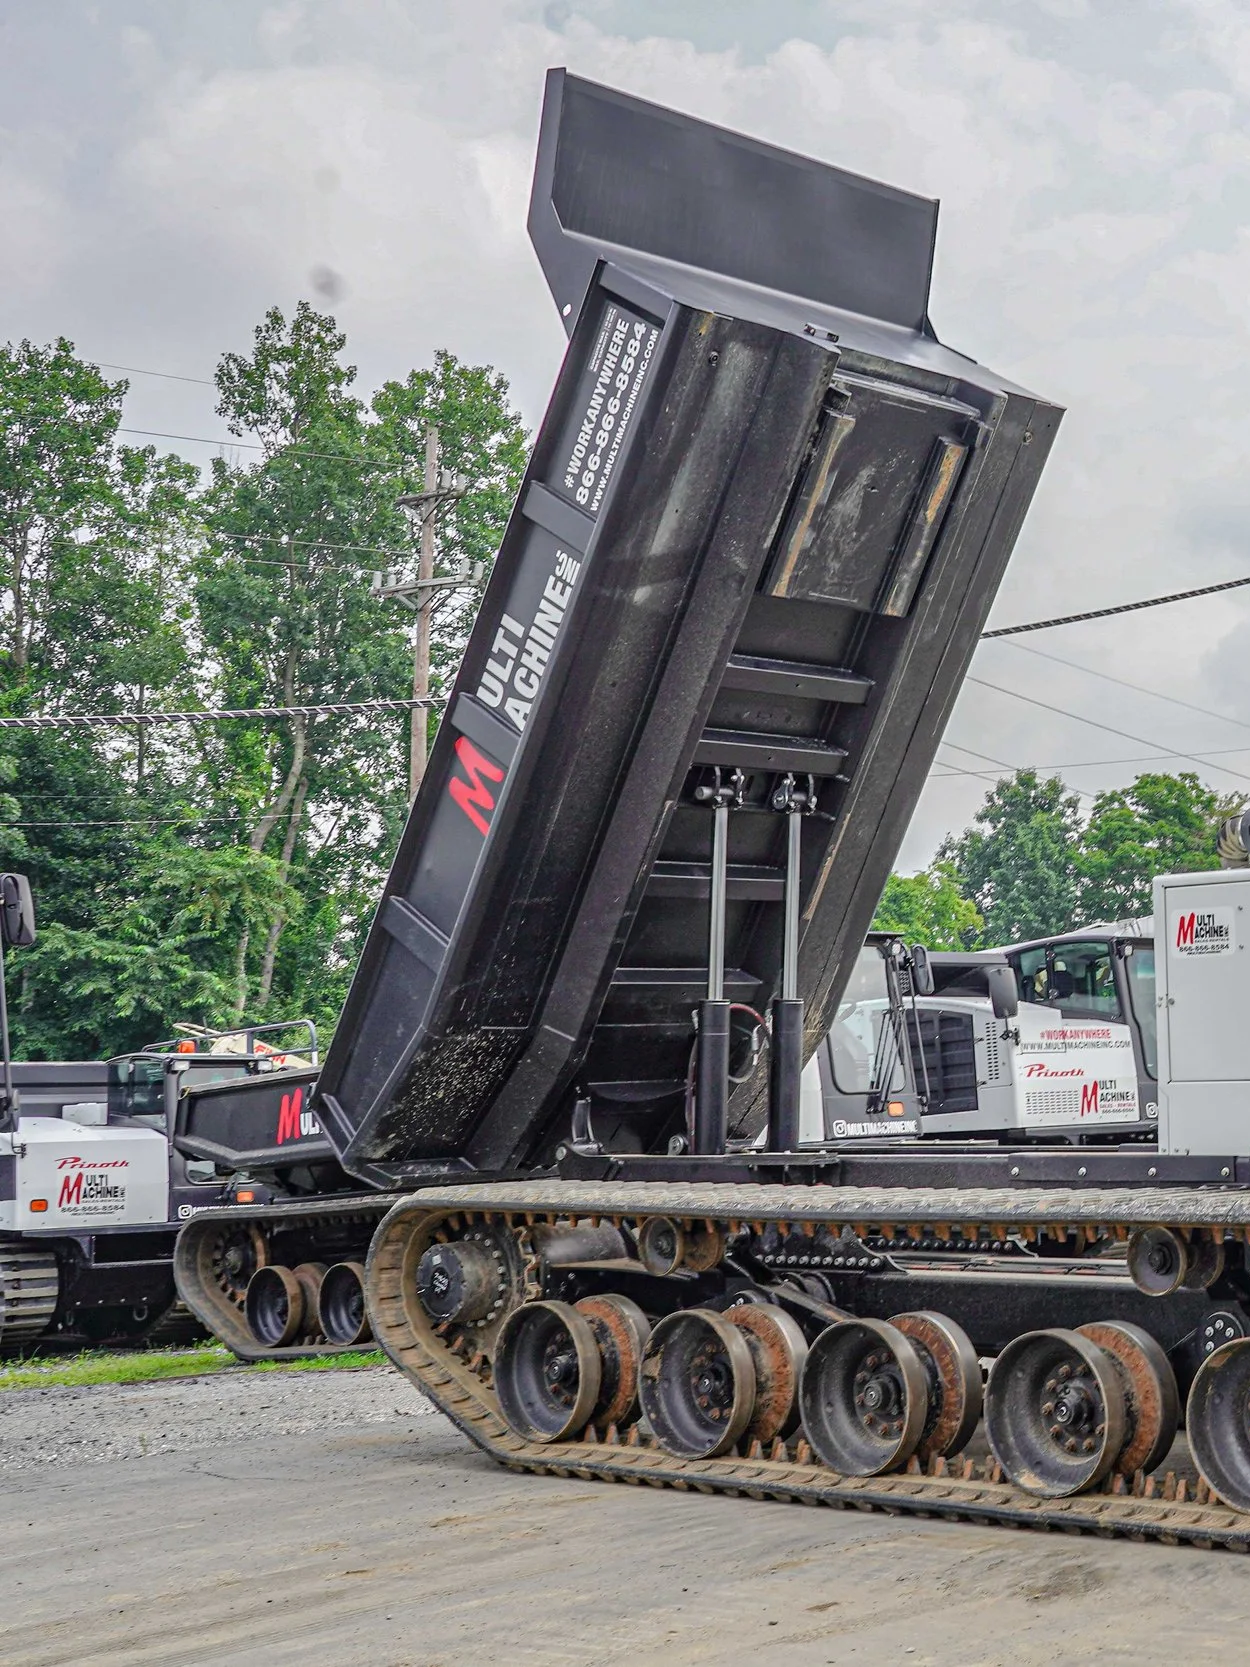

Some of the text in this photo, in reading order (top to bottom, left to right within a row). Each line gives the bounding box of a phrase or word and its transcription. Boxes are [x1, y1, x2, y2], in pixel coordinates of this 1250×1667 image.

[564, 318, 629, 488] #WORKANYWHERE
[576, 321, 646, 505] 866-866-8584
[590, 329, 659, 511] WWW.MULTIMACHINEINC.COM
[1021, 1040, 1131, 1051] WWW.MULTIMACHINEINC.COM
[1024, 1063, 1084, 1078] Prinoth
[1040, 1028, 1112, 1041] #WORKANYWHERE
